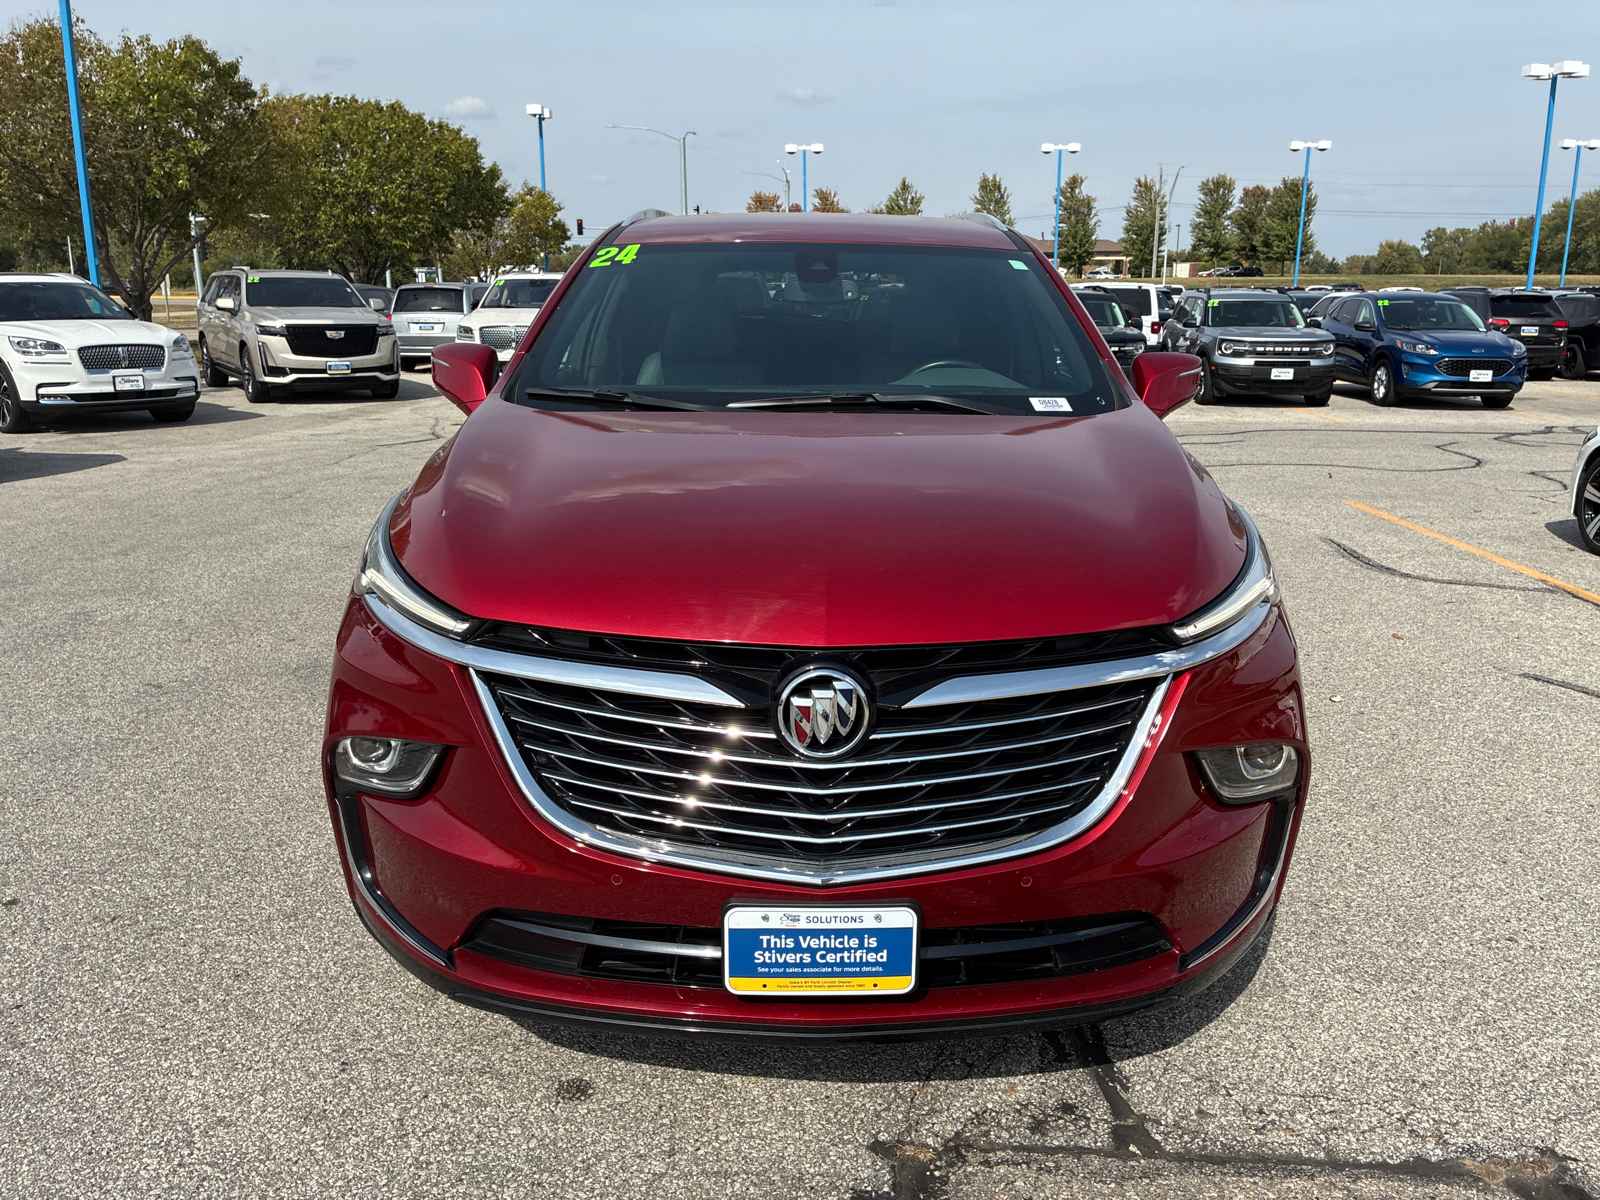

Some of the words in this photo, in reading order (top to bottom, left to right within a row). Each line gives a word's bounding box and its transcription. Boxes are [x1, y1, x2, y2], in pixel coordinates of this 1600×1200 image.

[588, 243, 641, 268] 24
[805, 915, 864, 924] SOLUTIONS
[759, 935, 795, 948] This
[798, 935, 859, 948] Vehicle
[863, 934, 878, 948] is
[753, 949, 812, 964] Stivers
[815, 949, 888, 963] Certified
